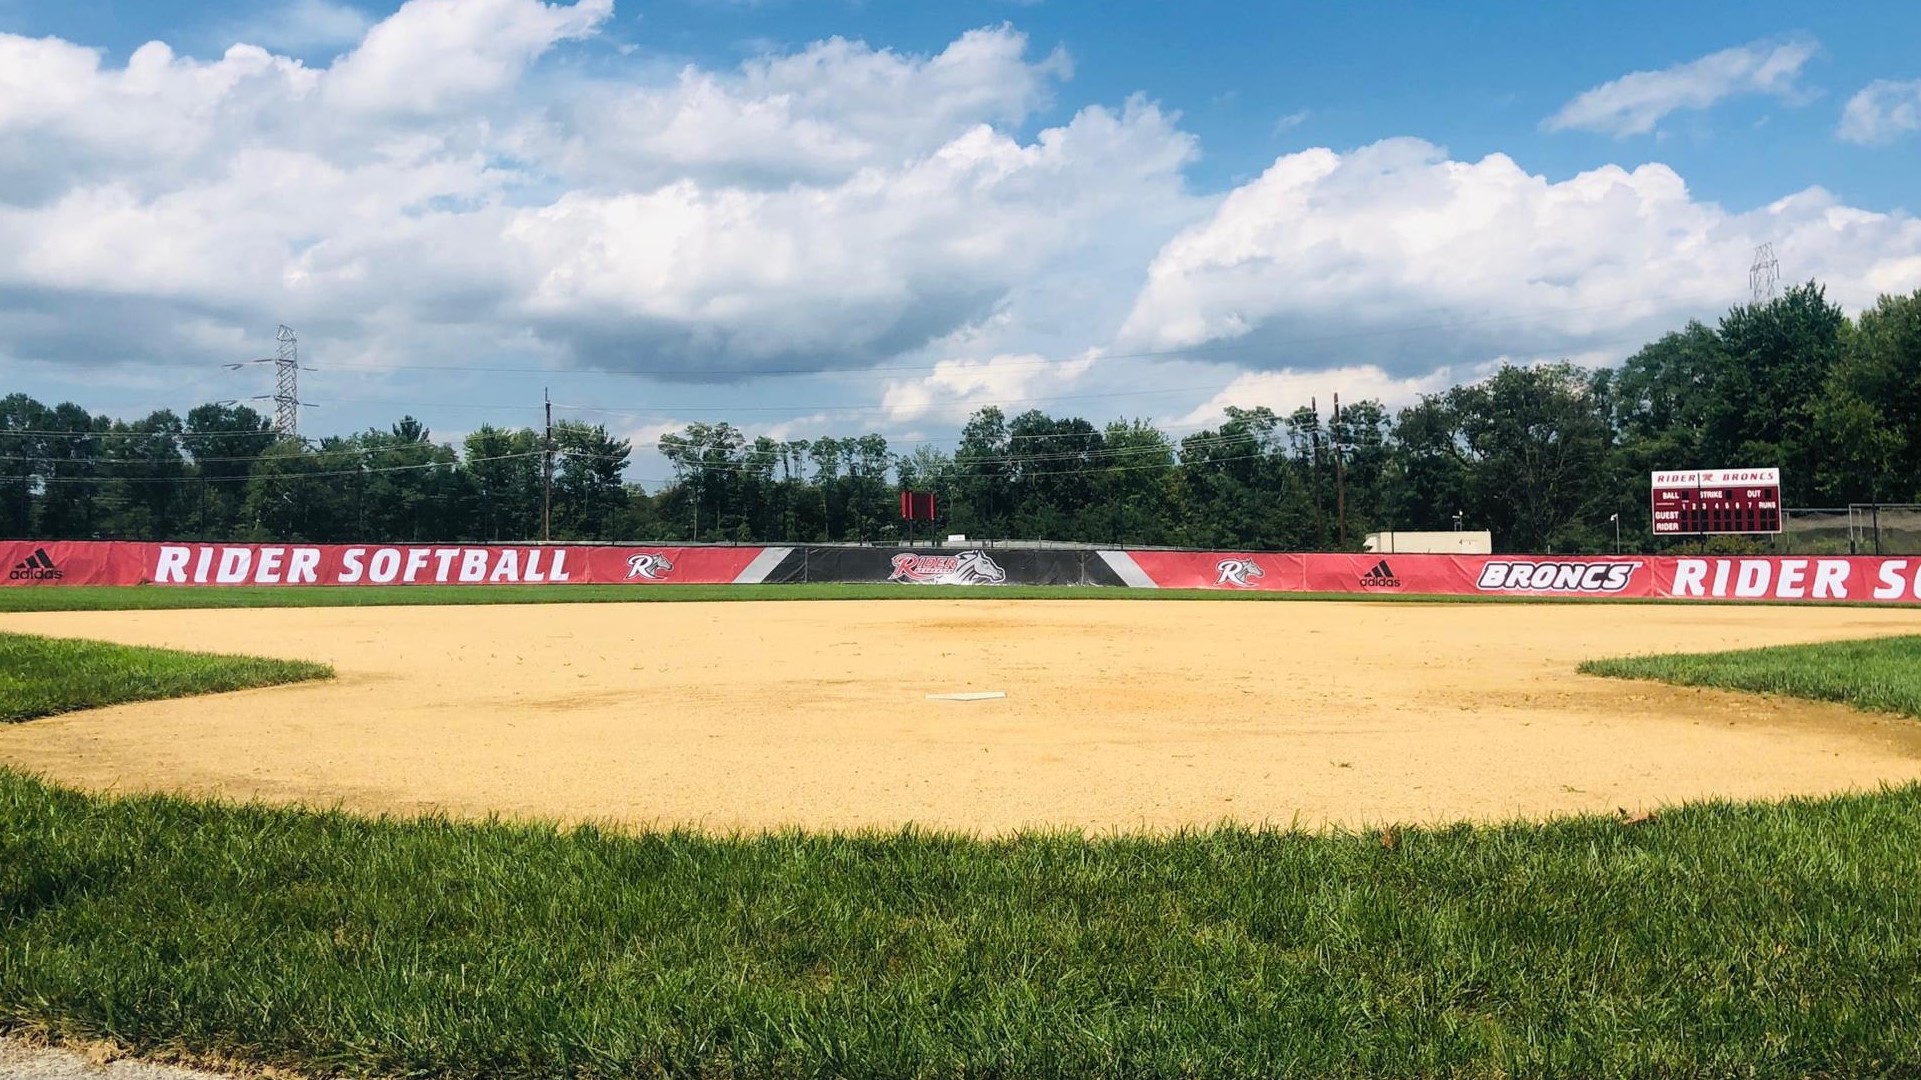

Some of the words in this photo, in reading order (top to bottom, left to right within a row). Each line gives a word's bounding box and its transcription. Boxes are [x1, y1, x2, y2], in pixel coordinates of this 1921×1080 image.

[1657, 474, 1696, 483] RIDER
[1723, 472, 1774, 481] BRONCS
[1662, 491, 1680, 500] BALL
[1700, 490, 1723, 499] STRIKE
[1747, 489, 1761, 498] OUT
[1682, 503, 1686, 511] 1
[1692, 503, 1697, 511] 2
[1714, 502, 1719, 510] 4
[1759, 501, 1776, 509] RUNS
[1655, 511, 1679, 520] GUEST
[1656, 523, 1679, 531] RIDER
[154, 546, 321, 584] RIDER
[337, 547, 571, 583] SOFTBALL
[888, 553, 959, 580] RIDER
[9, 568, 63, 580] adidas
[1478, 562, 1634, 590] BRONCS
[1671, 558, 1851, 599] RIDER
[1873, 559, 1921, 600] S
[1359, 577, 1401, 587] adidas
